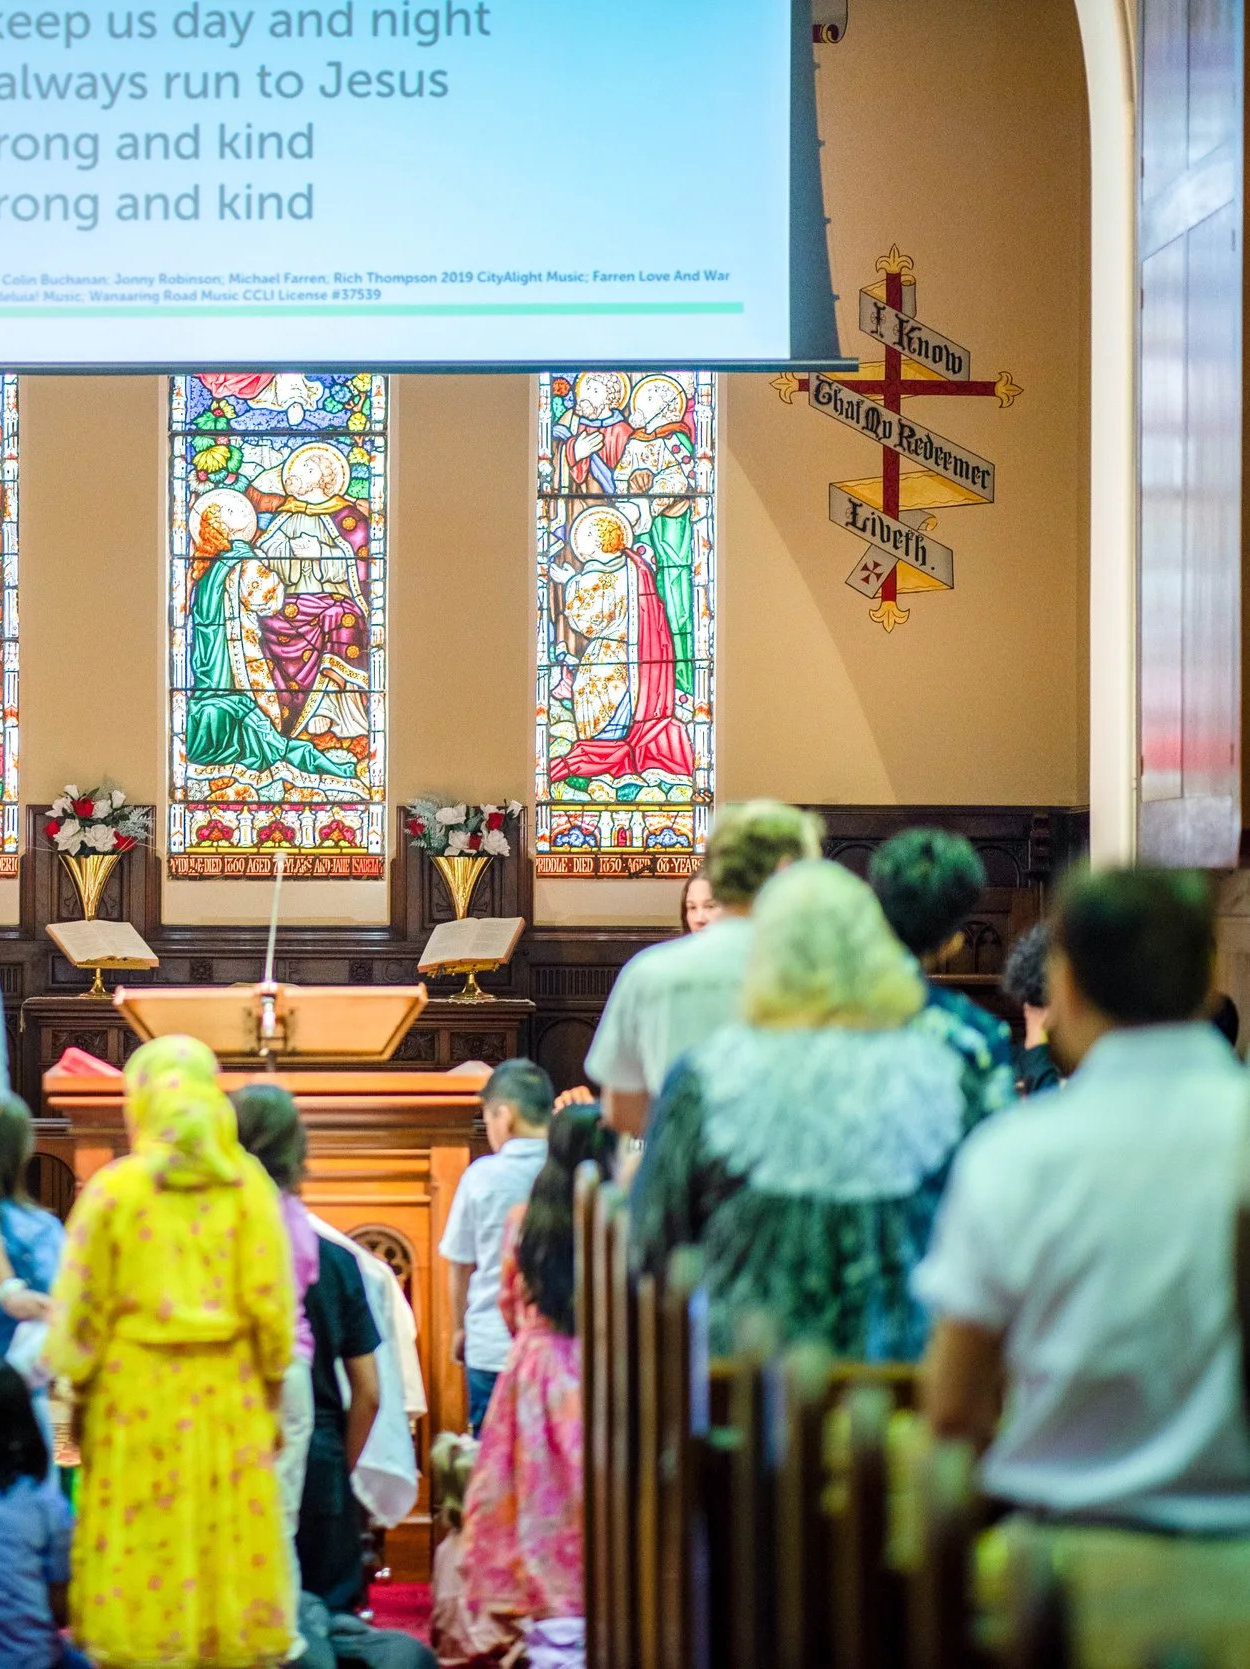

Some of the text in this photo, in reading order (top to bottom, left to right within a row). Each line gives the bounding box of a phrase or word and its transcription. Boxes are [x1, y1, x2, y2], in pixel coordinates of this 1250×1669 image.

[107, 9, 158, 39] us
[172, 1, 255, 48] day
[268, 0, 353, 38] and
[371, 0, 491, 47] night
[164, 70, 240, 100] run
[256, 64, 305, 99] to
[318, 61, 449, 98] Jesus
[115, 123, 201, 161] and
[218, 122, 314, 160] kind
[115, 184, 201, 221] and
[218, 183, 314, 220] kind
[1, 273, 37, 286] Colin
[114, 273, 154, 288] Jonny
[229, 272, 280, 285] Michael
[334, 272, 363, 284] Rich
[367, 271, 437, 286] Thompson
[441, 271, 473, 283] 2019
[477, 271, 542, 285] CityAlight
[593, 270, 635, 282] Farren
[638, 270, 670, 282] Love
[673, 270, 700, 281] And
[703, 270, 730, 281] War
[89, 290, 160, 304] Wanaaring
[164, 290, 197, 301] Road
[201, 290, 239, 301] Music
[243, 289, 274, 301] CCLI
[278, 289, 328, 300] License
[331, 288, 382, 300] #37539
[869, 301, 964, 378] I Know
[814, 374, 864, 424] That
[894, 416, 991, 491] Redeemer
[204, 858, 222, 873] DIED
[247, 858, 271, 873] AGED
[313, 858, 331, 873] AND
[573, 857, 594, 873] DIED
